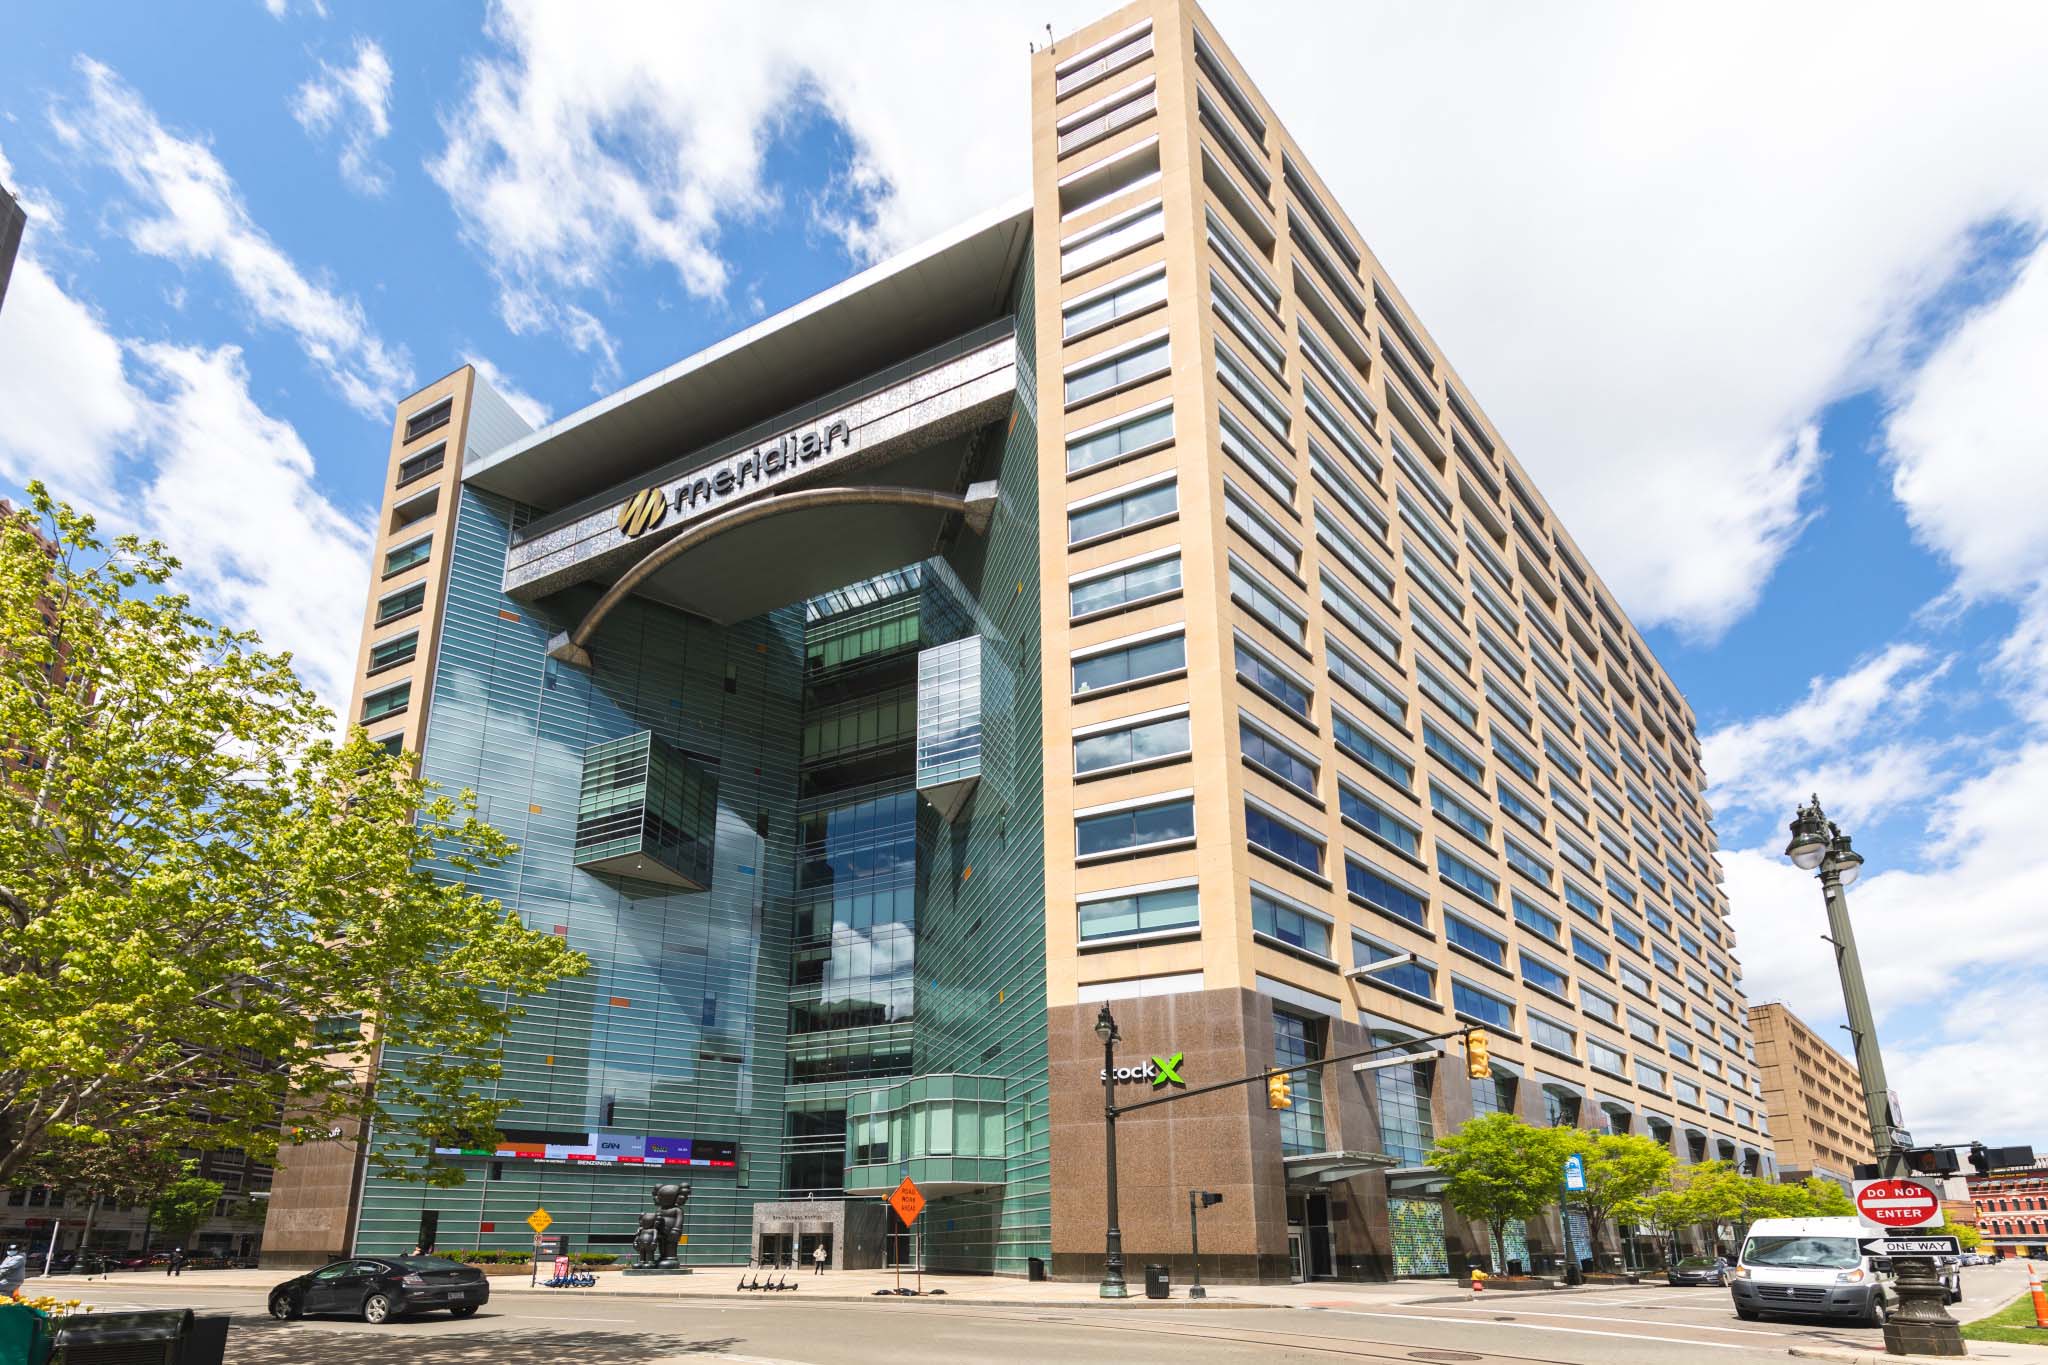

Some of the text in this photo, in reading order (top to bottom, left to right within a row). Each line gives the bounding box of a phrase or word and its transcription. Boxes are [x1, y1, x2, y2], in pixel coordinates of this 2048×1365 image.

[673, 418, 850, 511] meridian
[577, 1159, 612, 1167] BENZINGA
[1867, 1187, 1922, 1198] DO NOT
[1876, 1209, 1922, 1218] ENTER
[1887, 1242, 1947, 1251] ONE WAY
